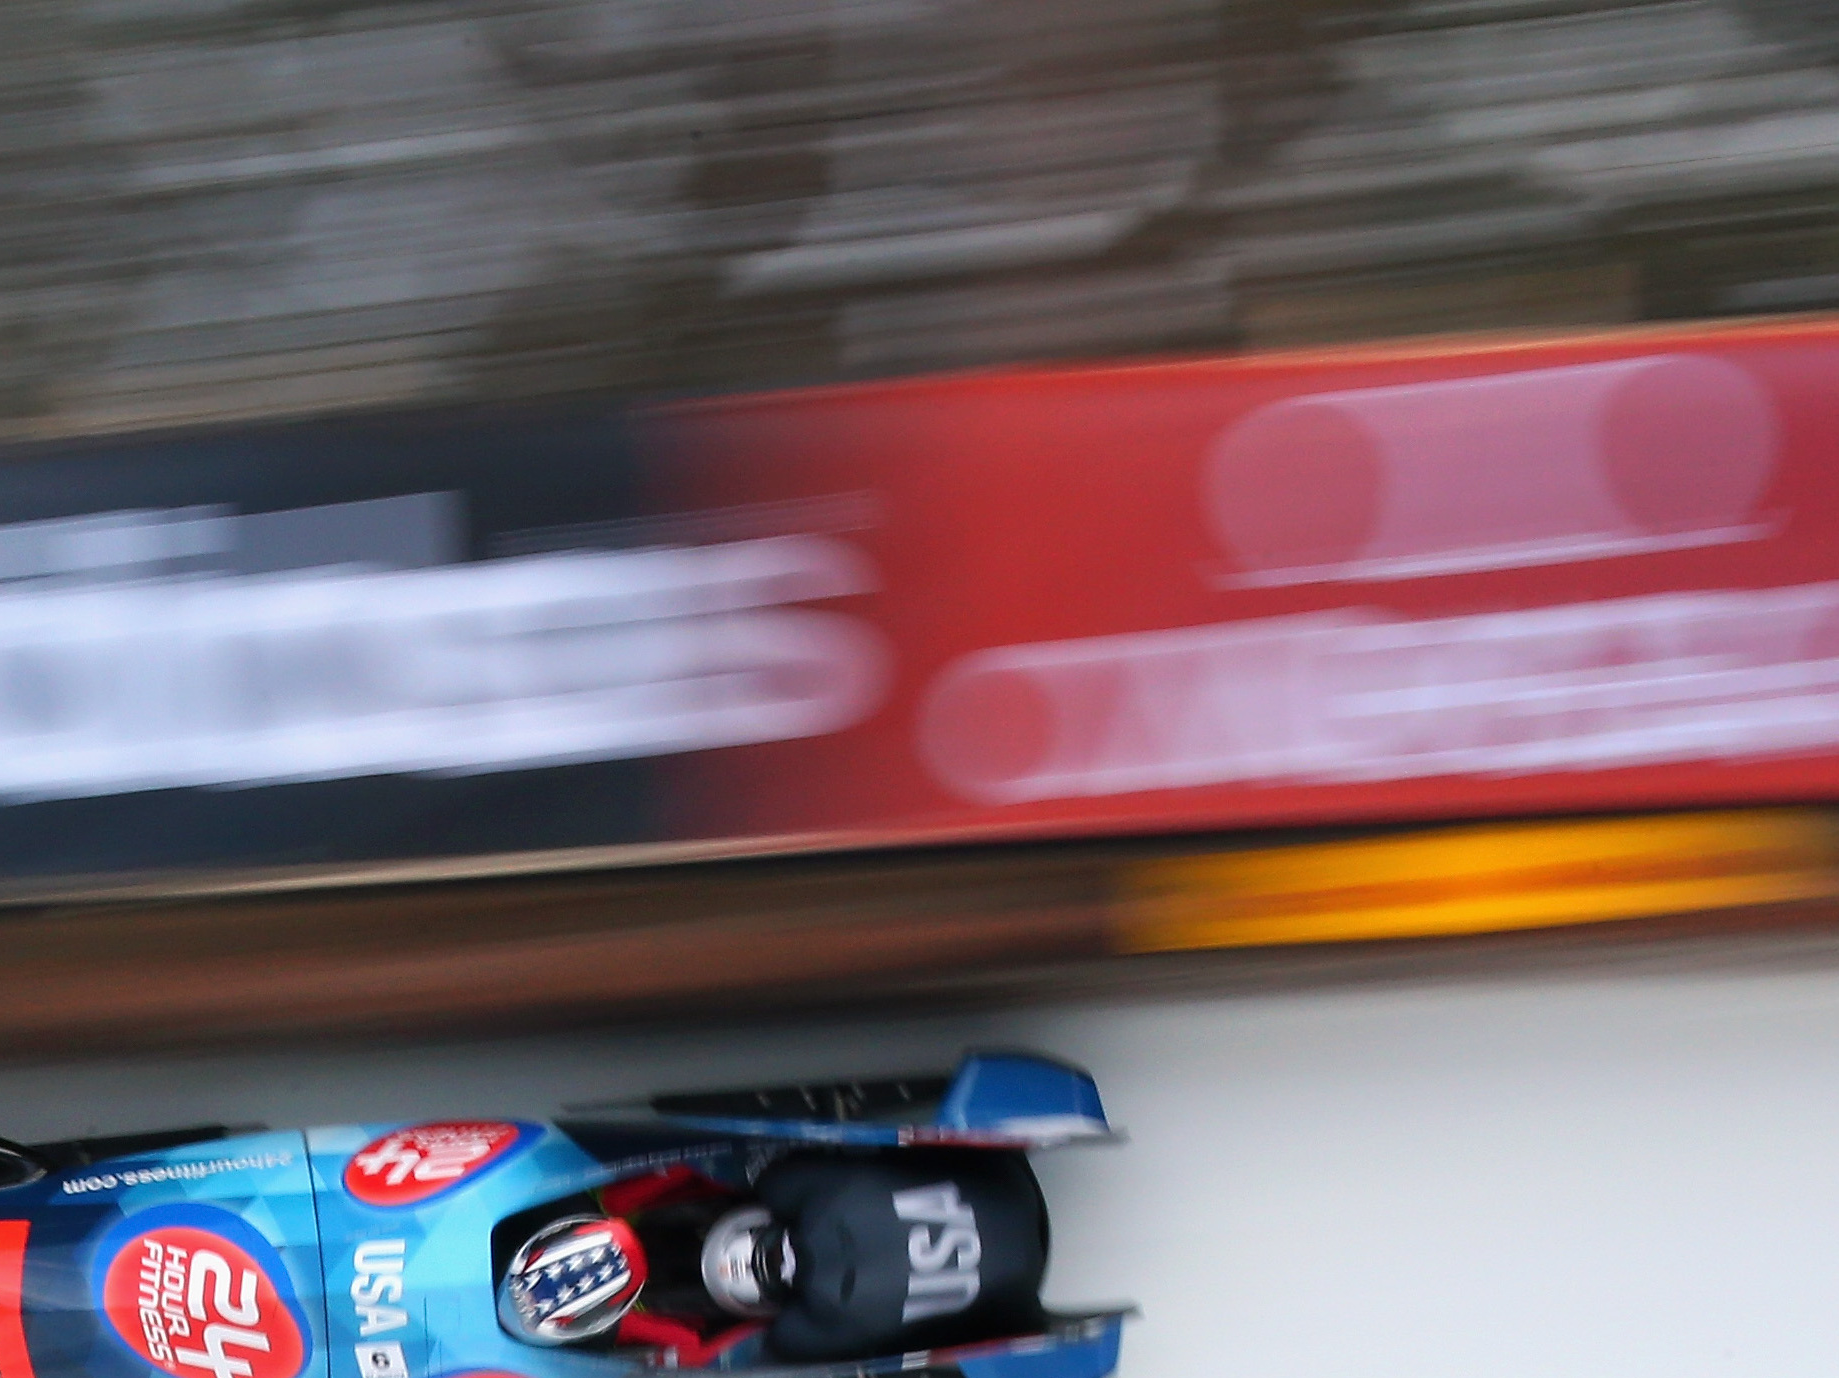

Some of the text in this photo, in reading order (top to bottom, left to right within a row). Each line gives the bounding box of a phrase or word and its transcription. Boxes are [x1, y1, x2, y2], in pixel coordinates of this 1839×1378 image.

[138, 1238, 174, 1361] FITNESS
[161, 1244, 191, 1337] HOUR
[350, 1238, 408, 1337] USA
[892, 1181, 982, 1323] USA
